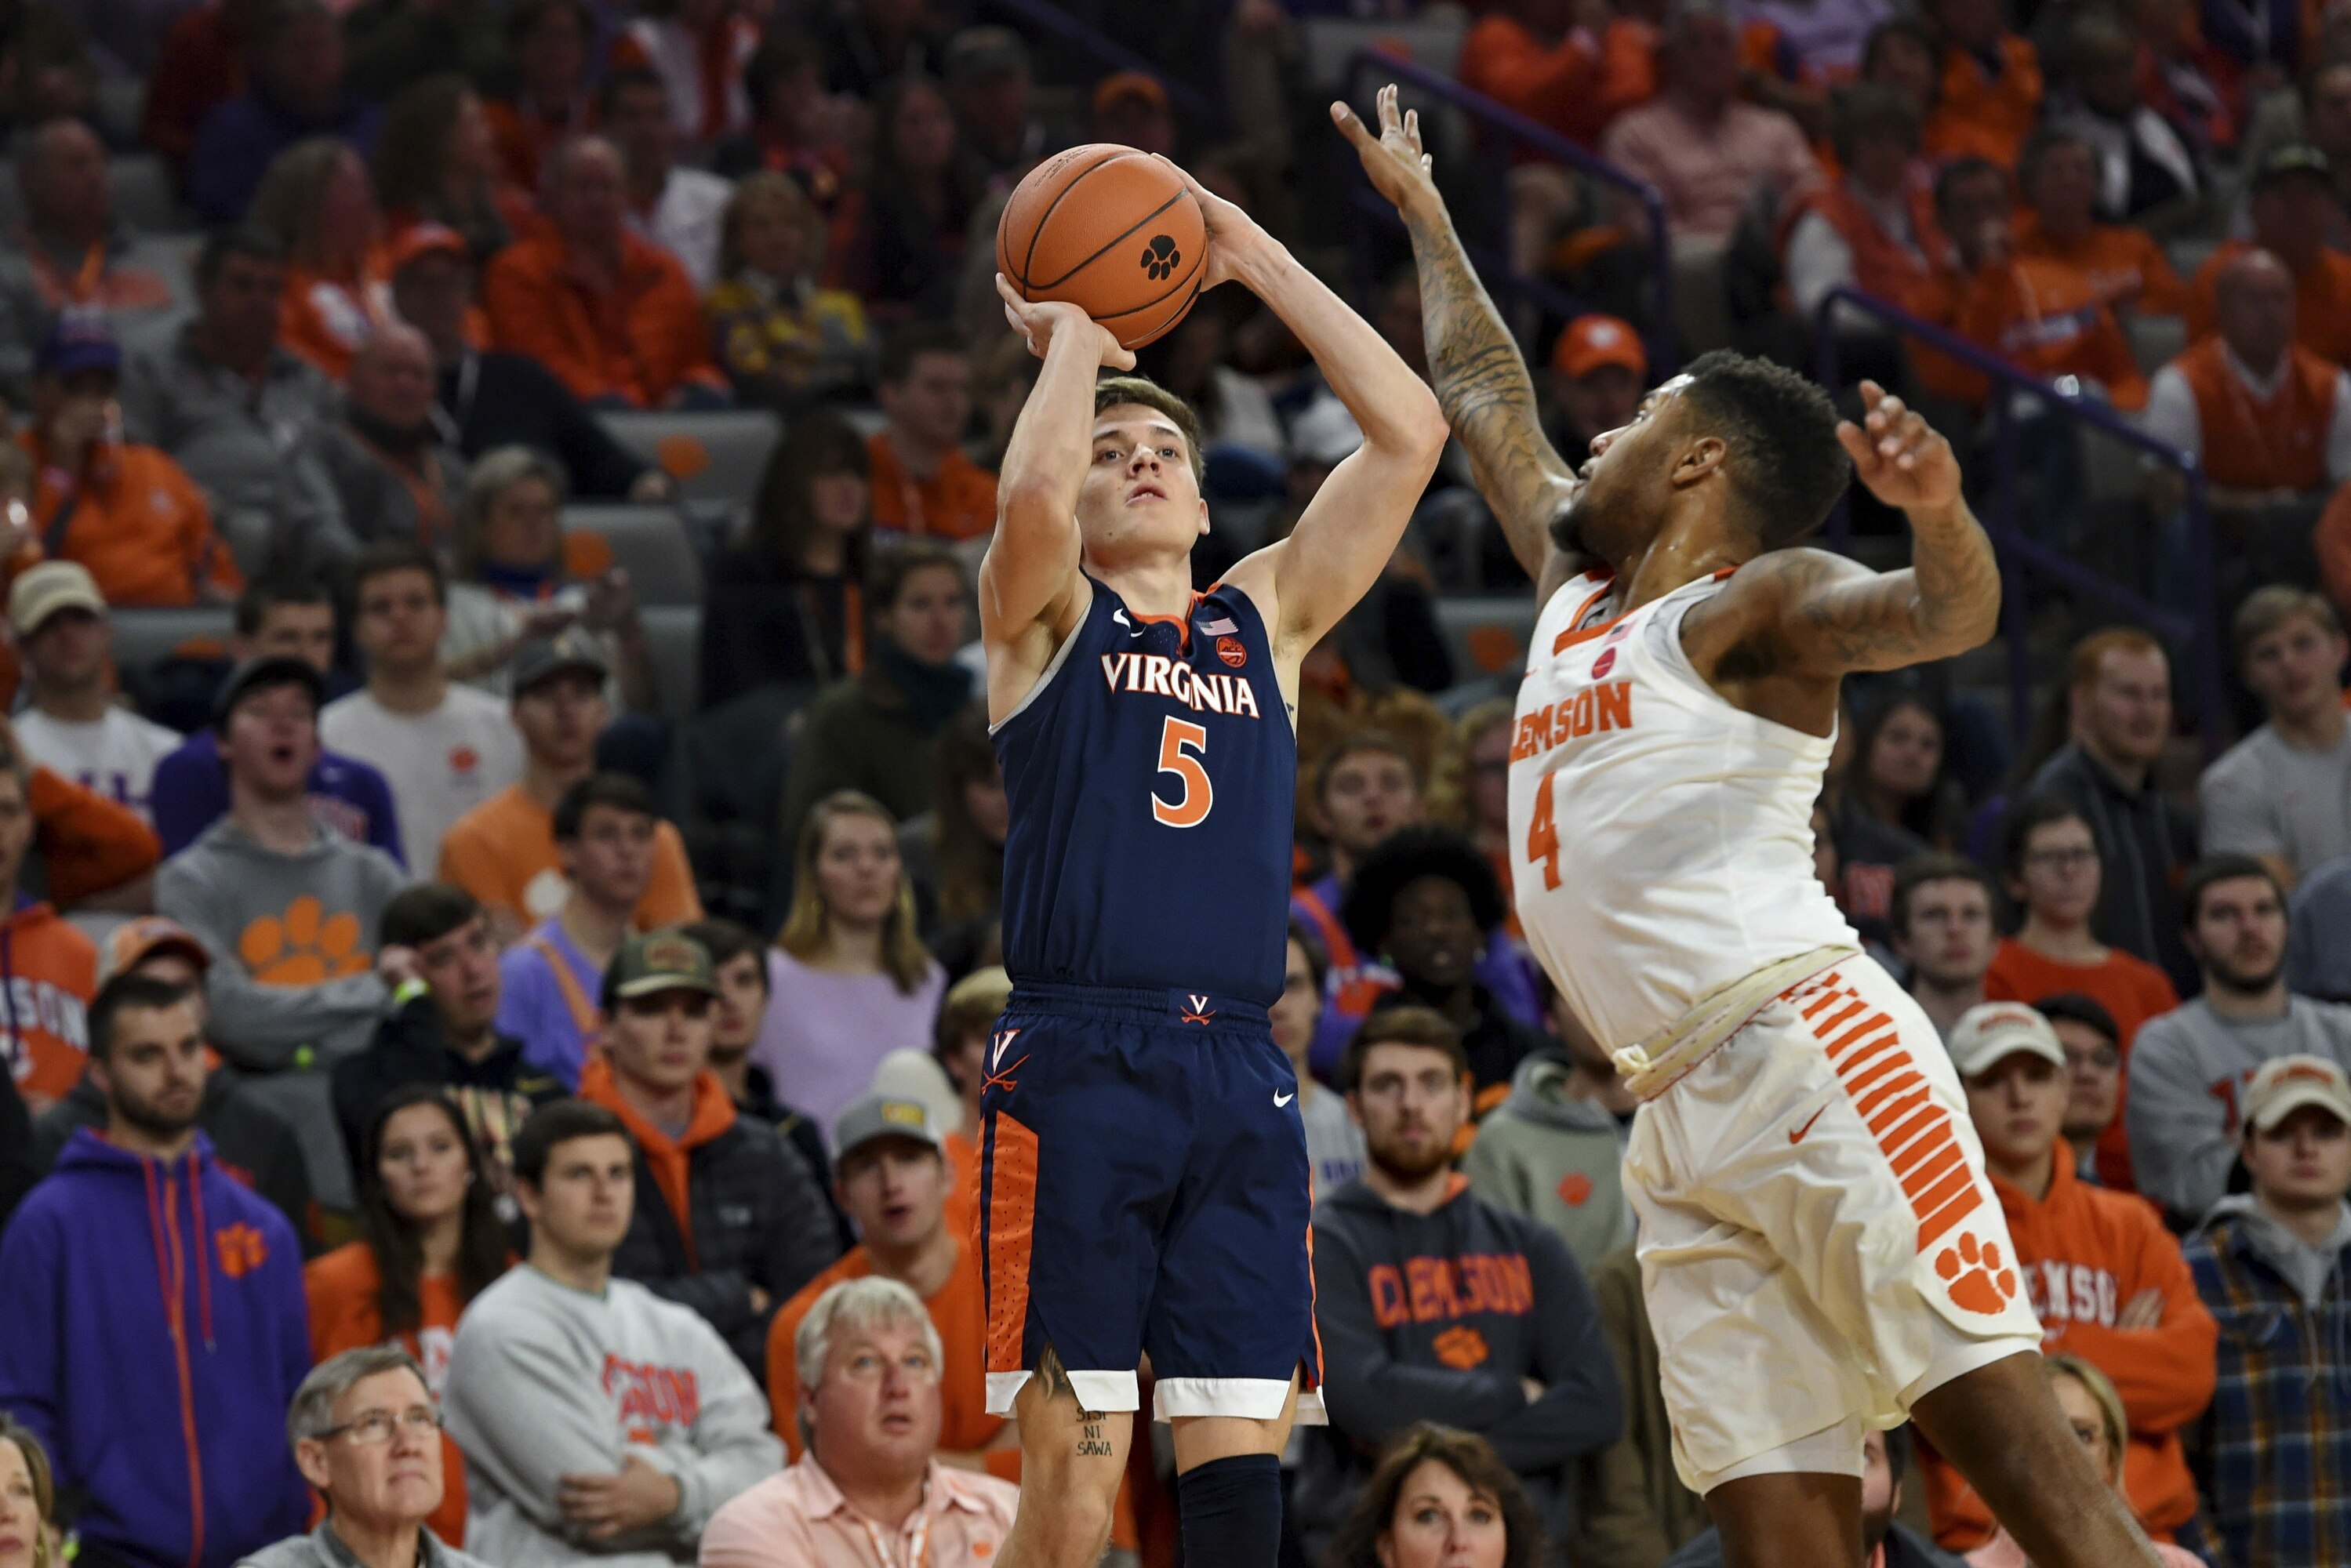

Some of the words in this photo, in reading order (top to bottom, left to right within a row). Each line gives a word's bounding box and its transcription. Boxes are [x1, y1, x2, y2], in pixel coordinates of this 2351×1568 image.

[1509, 681, 1632, 764] LEMSON
[1151, 714, 1213, 829] 5
[1528, 770, 1561, 892] 4
[0, 976, 89, 1048] SON
[1188, 994, 1208, 1015] V
[992, 1029, 1020, 1075] V
[1077, 1441, 1112, 1457] SAWA
[1084, 1425, 1100, 1439] NI
